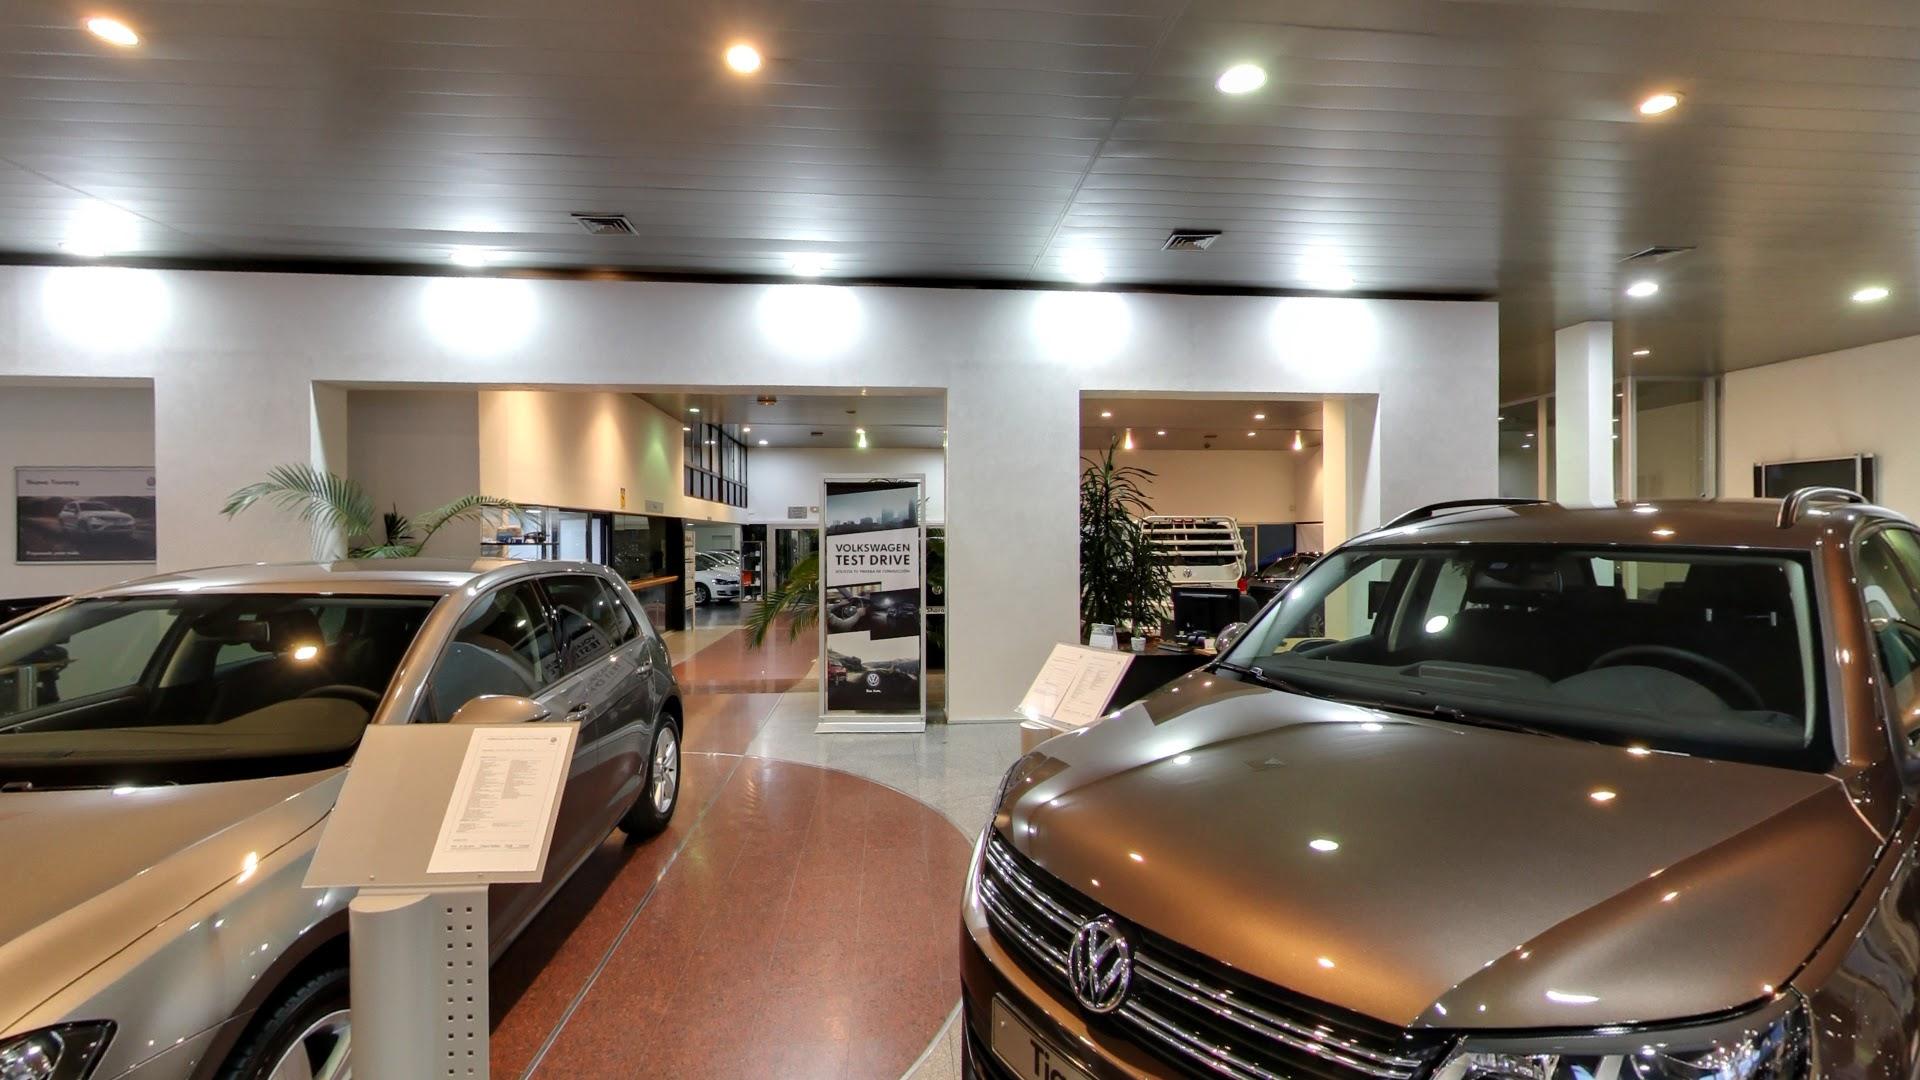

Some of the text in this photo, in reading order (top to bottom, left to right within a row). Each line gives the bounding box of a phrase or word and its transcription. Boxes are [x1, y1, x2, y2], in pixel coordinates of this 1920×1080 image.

[835, 543, 910, 553] VOLKSWAGEN
[835, 554, 910, 566] TEST DRIVE
